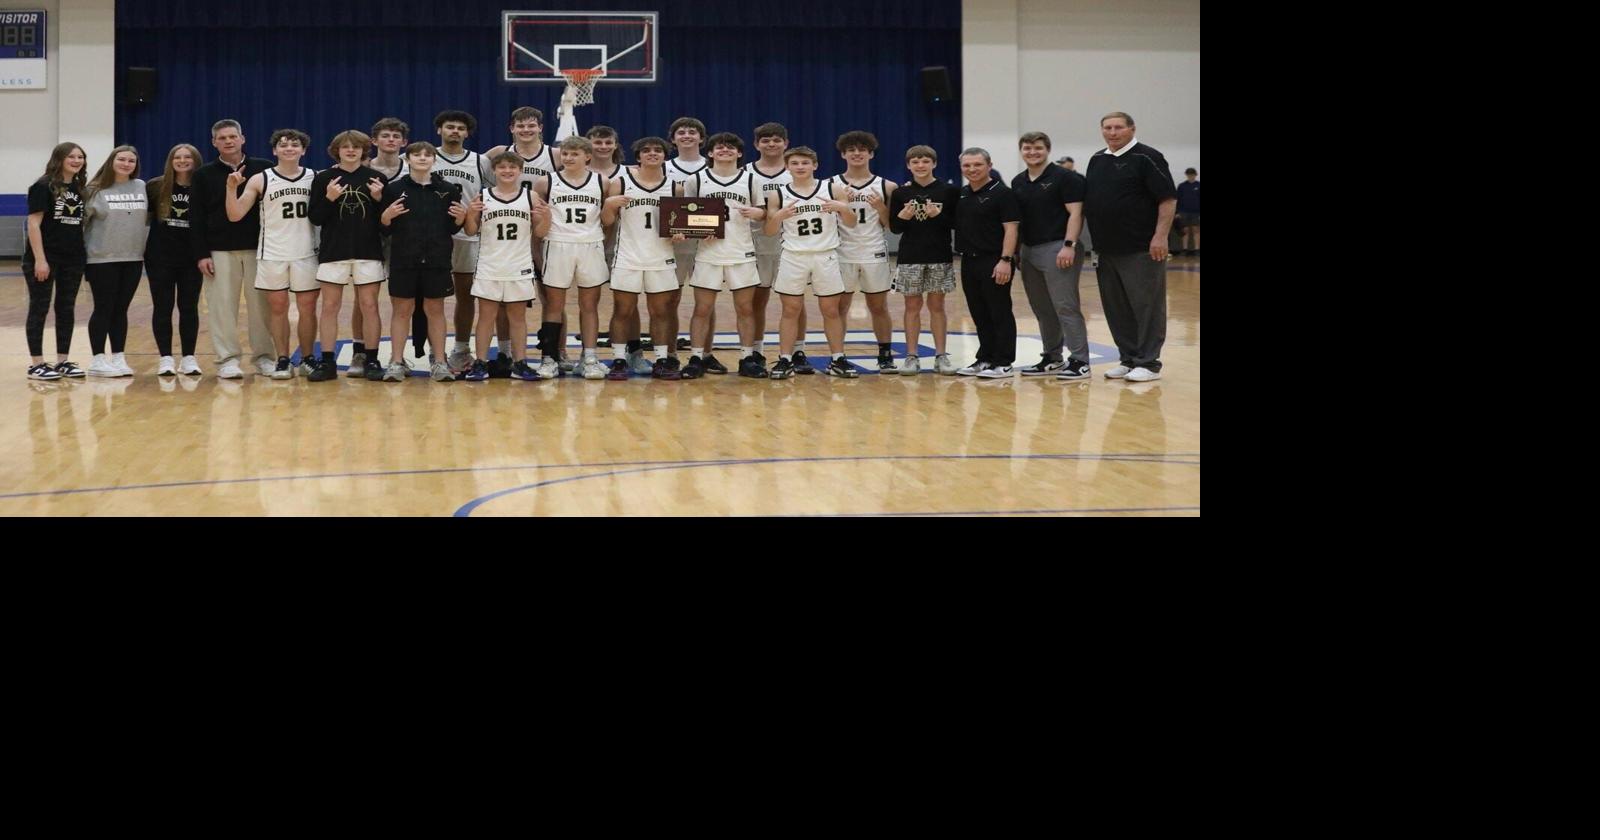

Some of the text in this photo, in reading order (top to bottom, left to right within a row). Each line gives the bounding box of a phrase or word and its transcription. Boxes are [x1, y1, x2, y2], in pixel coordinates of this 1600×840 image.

[0, 13, 38, 24] ISITOR
[104, 193, 145, 201] INOLA
[551, 194, 600, 207] LONGHORNS
[282, 201, 308, 219] 20
[483, 208, 530, 222] LONGHORNS
[565, 208, 587, 224] 15
[644, 212, 652, 229] 1
[797, 217, 823, 236] 23
[496, 223, 518, 240] 12
